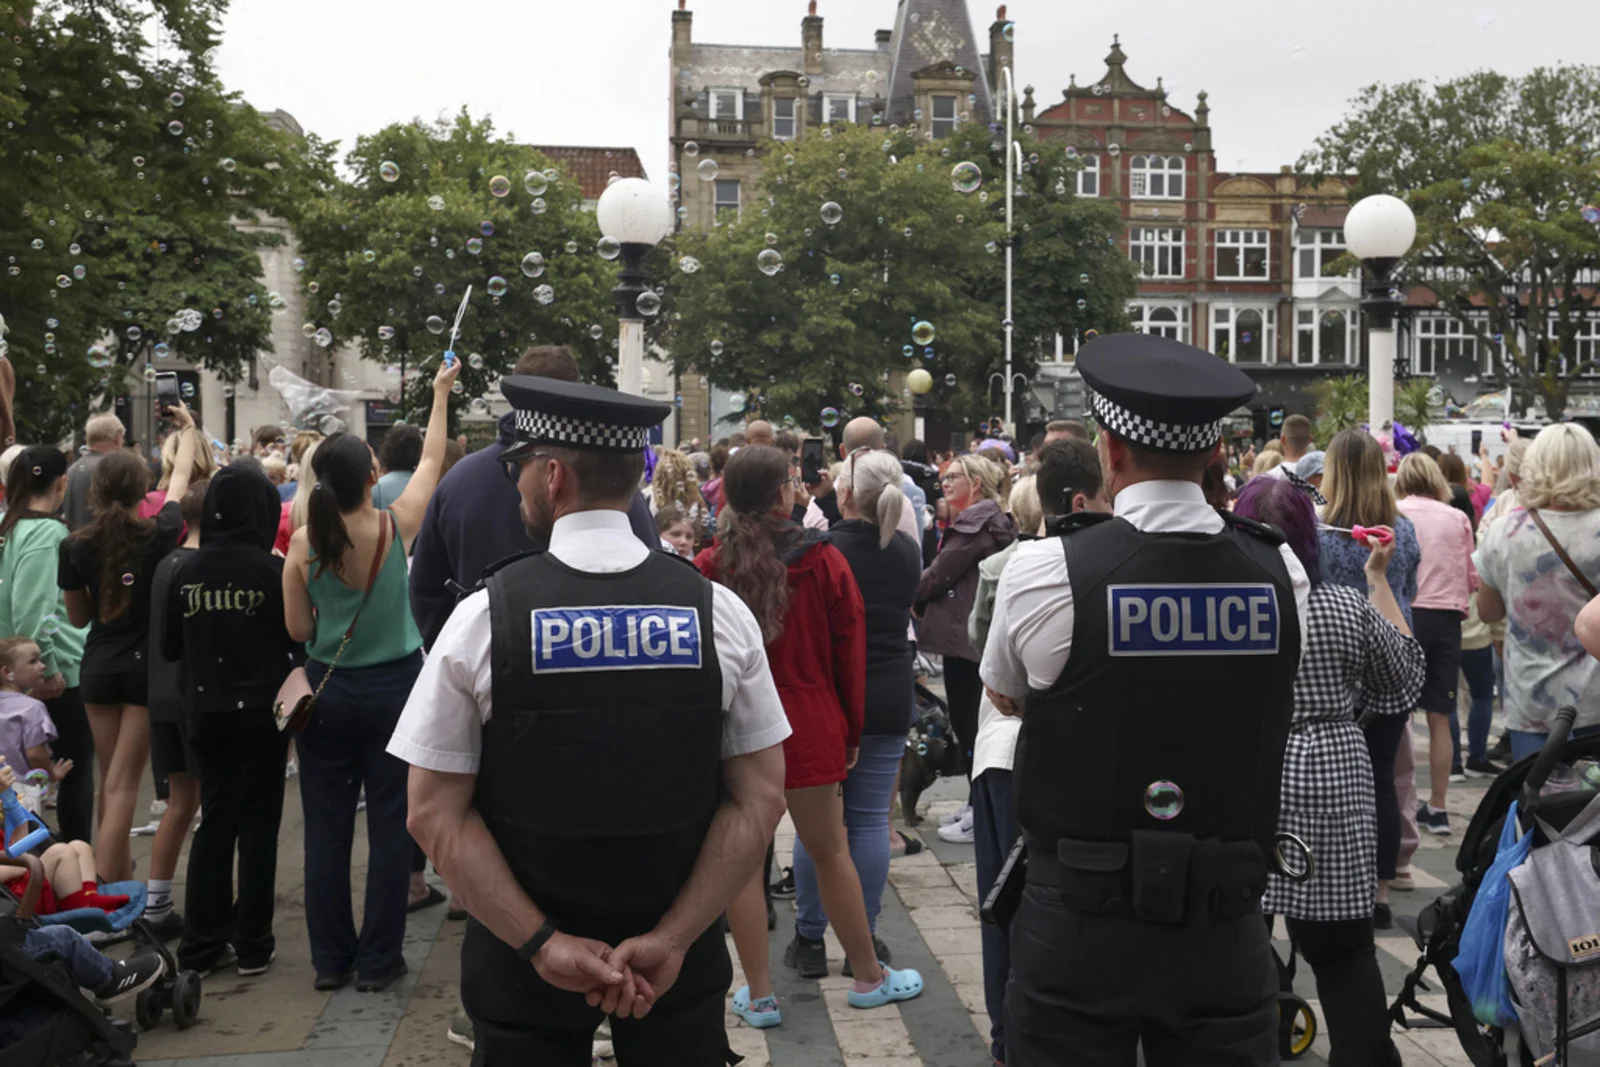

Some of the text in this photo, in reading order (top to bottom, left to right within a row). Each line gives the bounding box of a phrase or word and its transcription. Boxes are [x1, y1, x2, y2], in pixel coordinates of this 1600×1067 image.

[180, 582, 264, 618] Juicy
[1119, 596, 1272, 643] POLICE
[541, 615, 693, 660] POLICE
